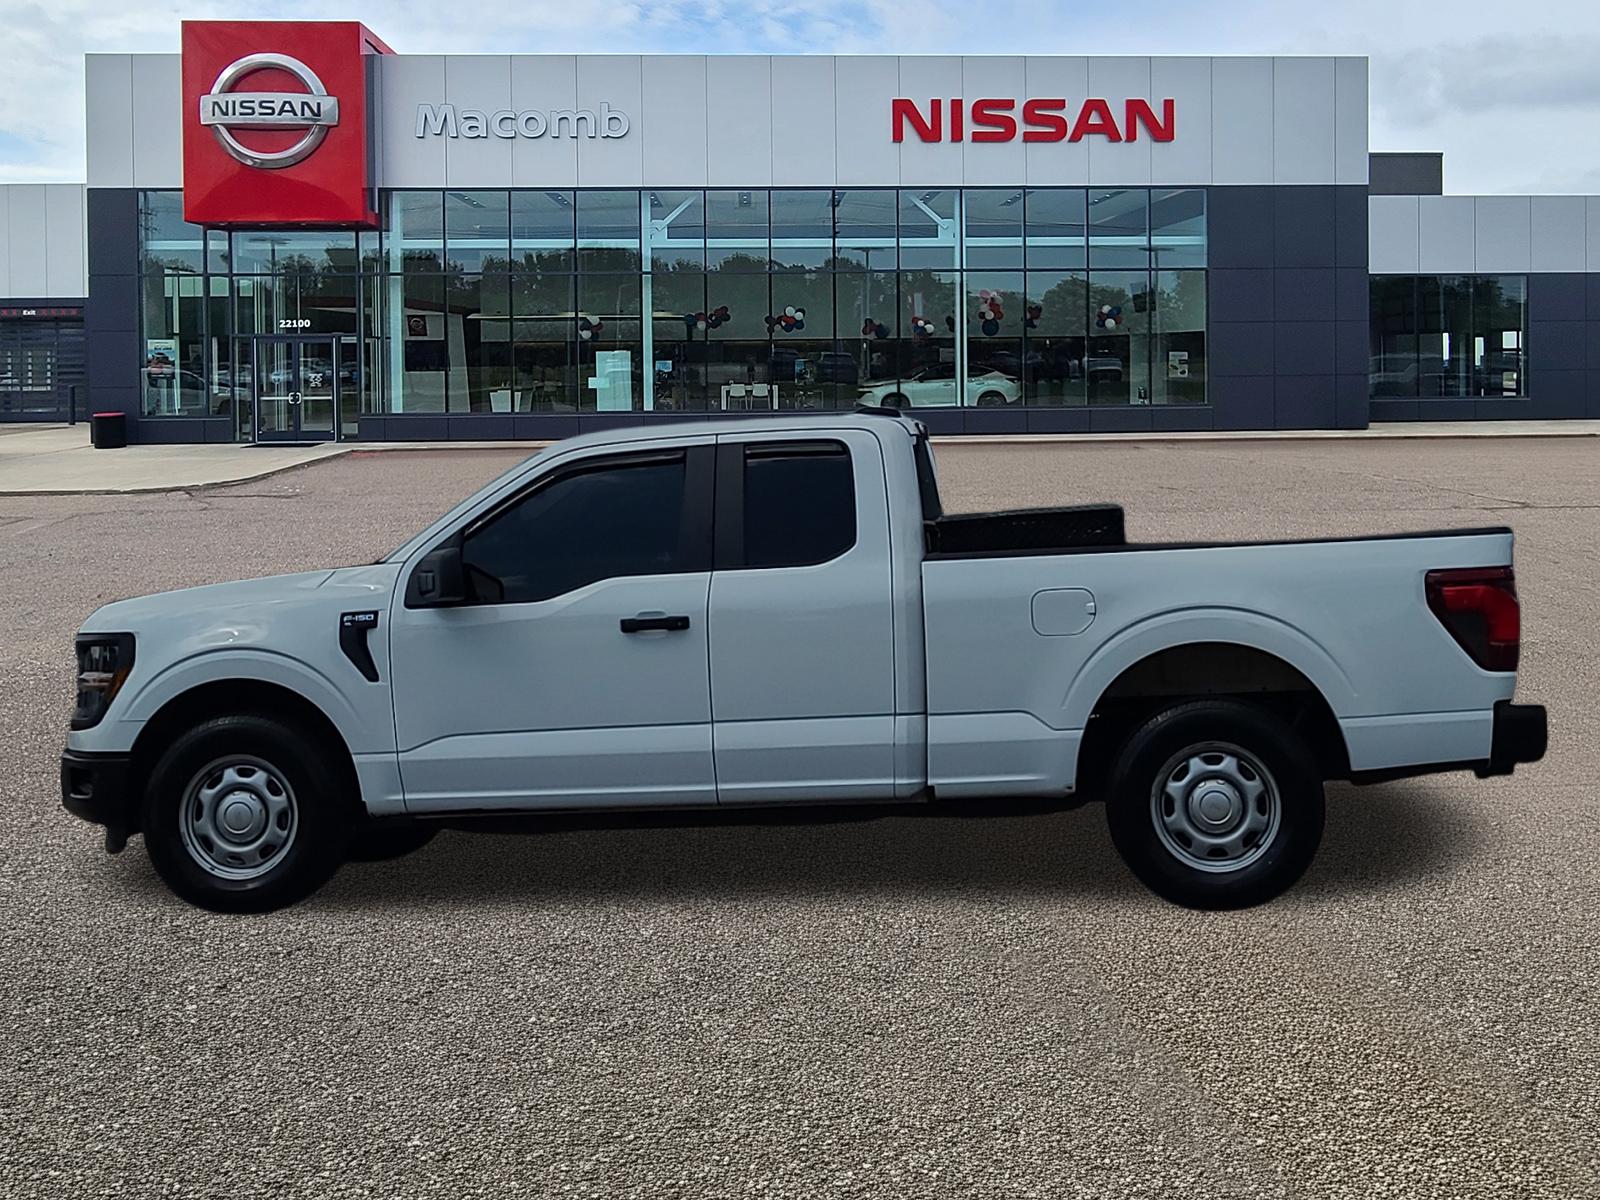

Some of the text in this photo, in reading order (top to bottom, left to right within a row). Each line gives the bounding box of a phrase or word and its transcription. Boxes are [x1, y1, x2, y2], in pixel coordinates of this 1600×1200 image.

[211, 100, 321, 118] NISSAN
[415, 101, 630, 139] Macomb
[892, 98, 1175, 143] NISSAN
[279, 319, 311, 328] 22100
